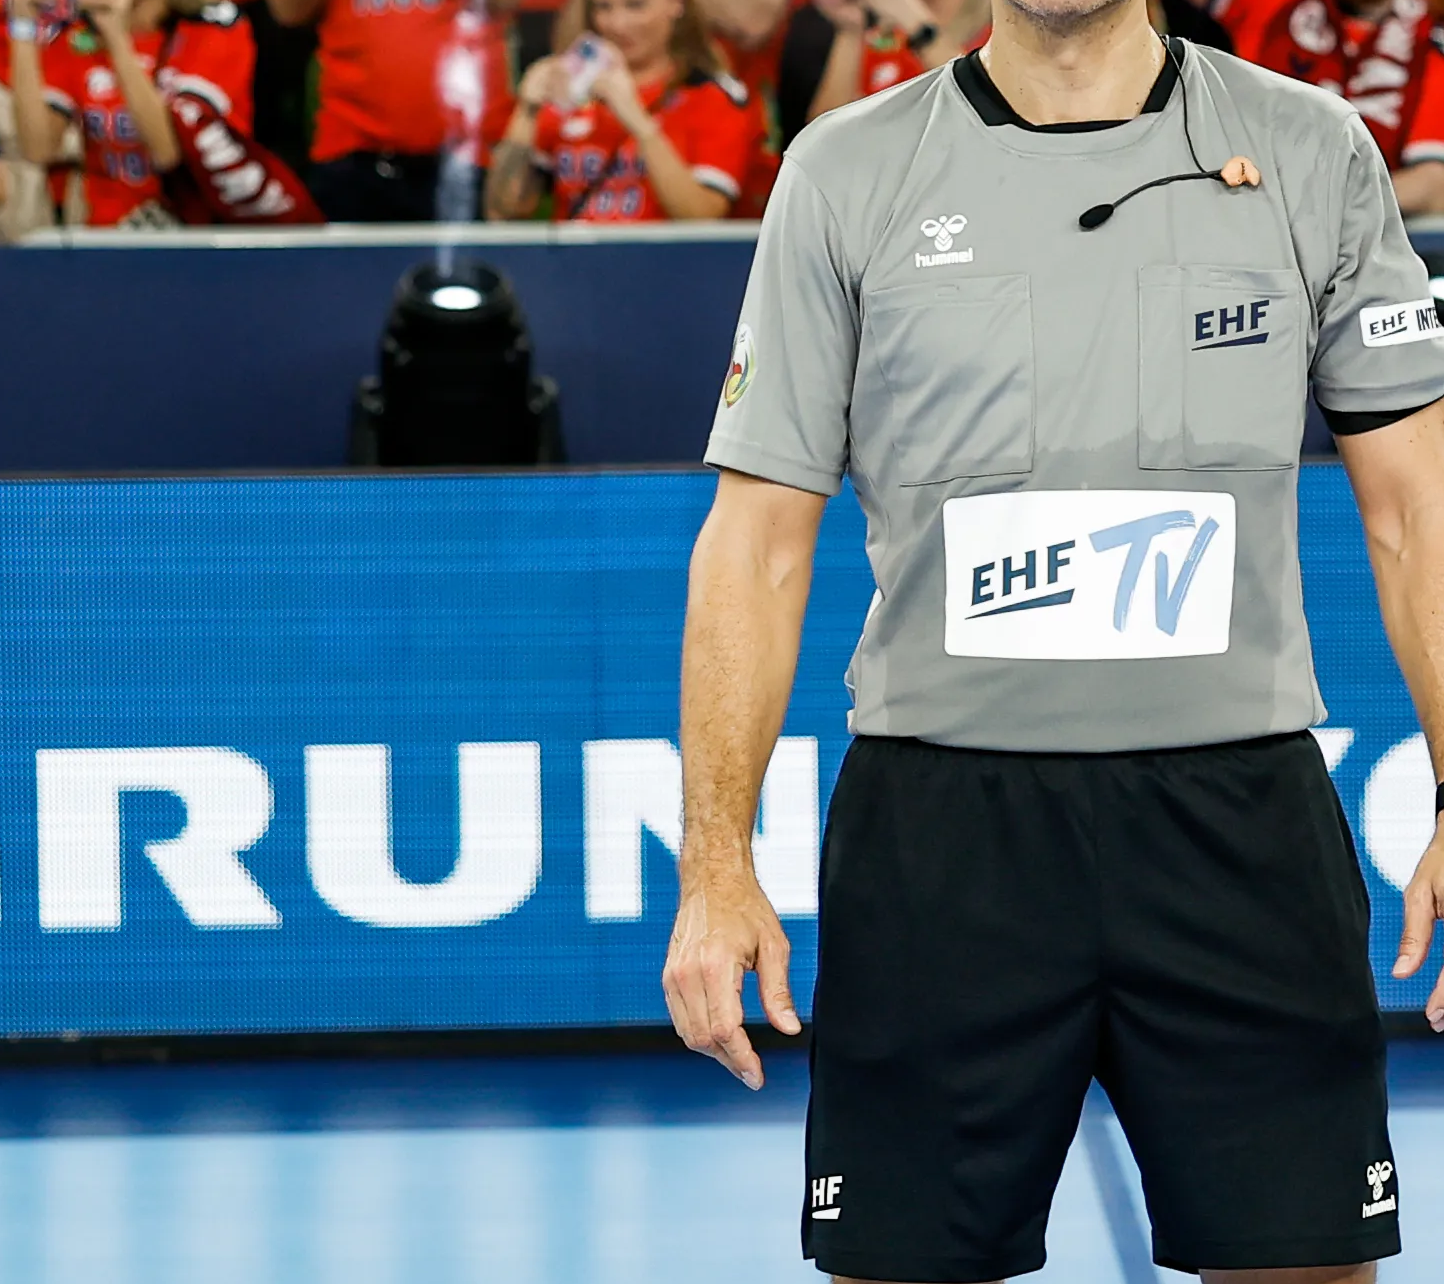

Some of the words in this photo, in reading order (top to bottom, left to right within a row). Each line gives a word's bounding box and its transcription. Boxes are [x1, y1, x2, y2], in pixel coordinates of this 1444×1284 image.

[915, 247, 973, 267] hummel
[1195, 299, 1270, 342] EHF
[1369, 310, 1406, 336] EHF
[1416, 306, 1443, 332] INTE
[971, 539, 1076, 607] EHF
[1088, 509, 1220, 637] TV
[811, 1175, 843, 1208] HF
